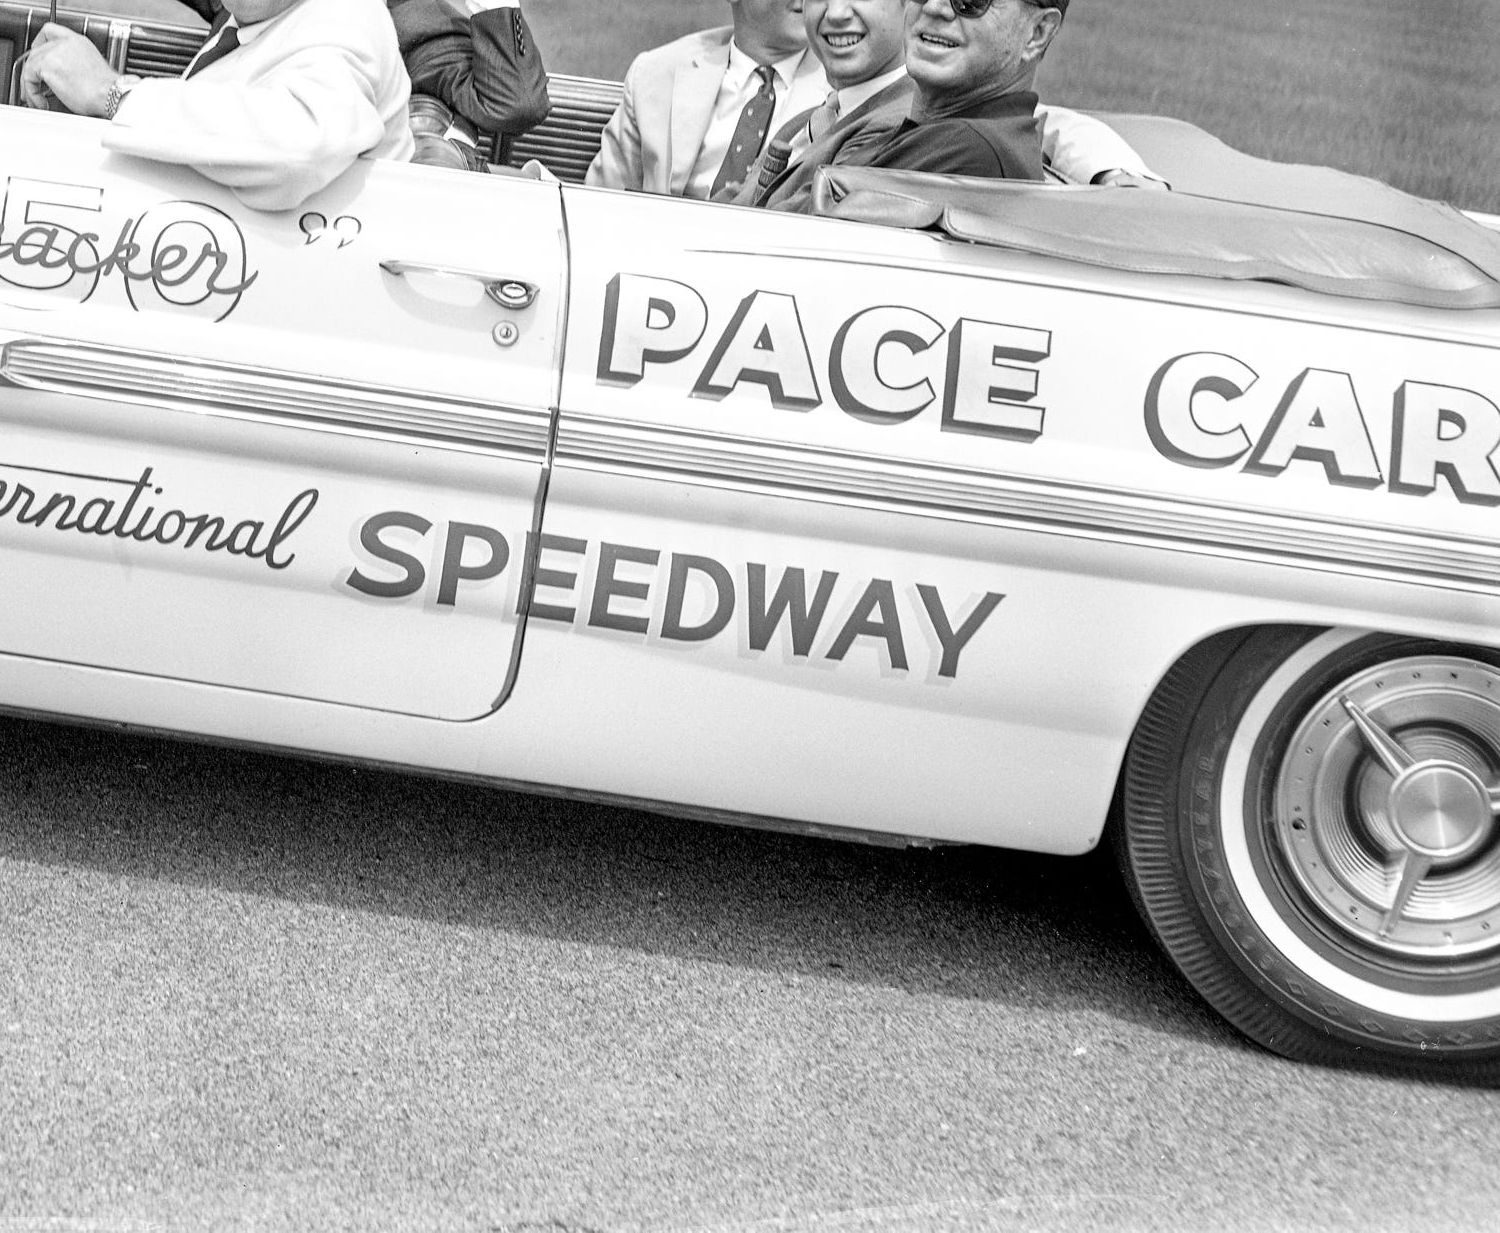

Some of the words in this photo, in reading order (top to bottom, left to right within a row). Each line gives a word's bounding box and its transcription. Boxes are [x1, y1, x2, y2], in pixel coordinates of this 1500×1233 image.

[596, 272, 1053, 443] PACE
[1143, 350, 1500, 508] CAR
[347, 510, 1005, 679] SPEEDWAY
